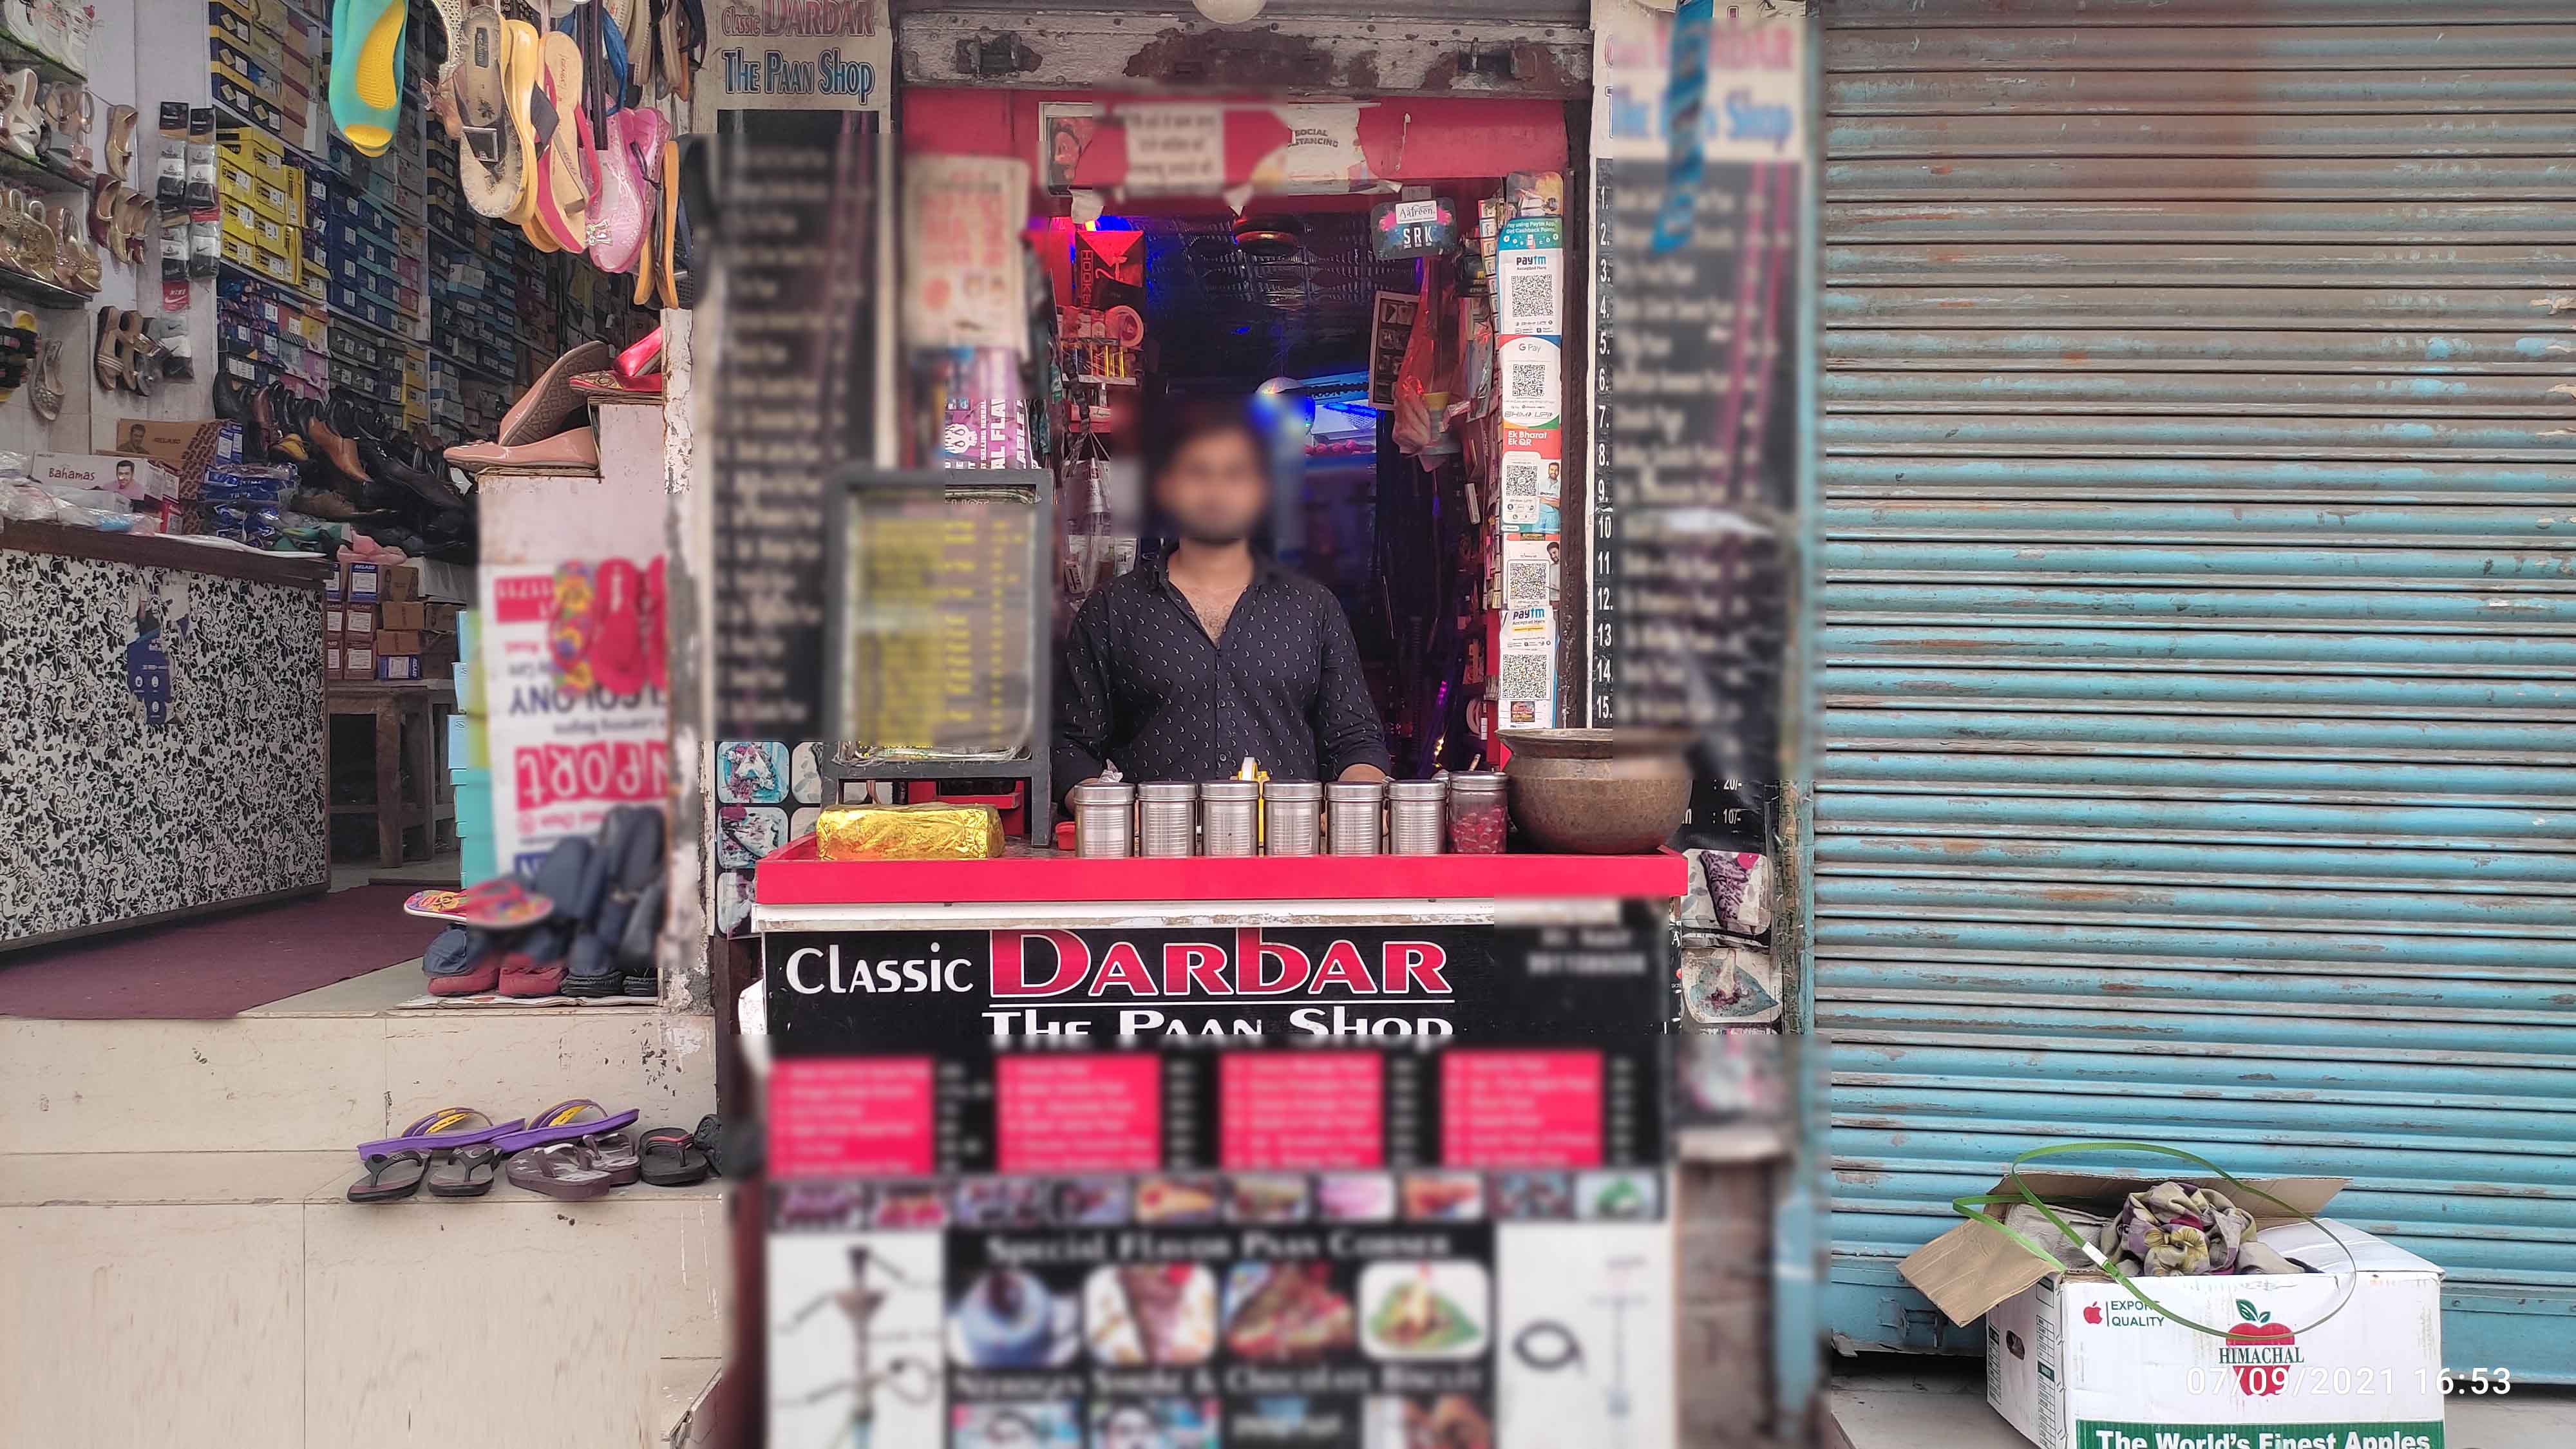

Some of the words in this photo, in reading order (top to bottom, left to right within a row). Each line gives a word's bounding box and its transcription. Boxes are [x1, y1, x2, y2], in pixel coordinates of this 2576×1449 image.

[48, 467, 95, 481] Bahamas
[2111, 1300, 2160, 1311] EXPO
[2112, 1316, 2165, 1327] QUALITY
[2219, 1347, 2304, 1365] HIMACHAL
[2095, 1430, 2148, 1449] The
[2259, 1432, 2337, 1449] Finest
